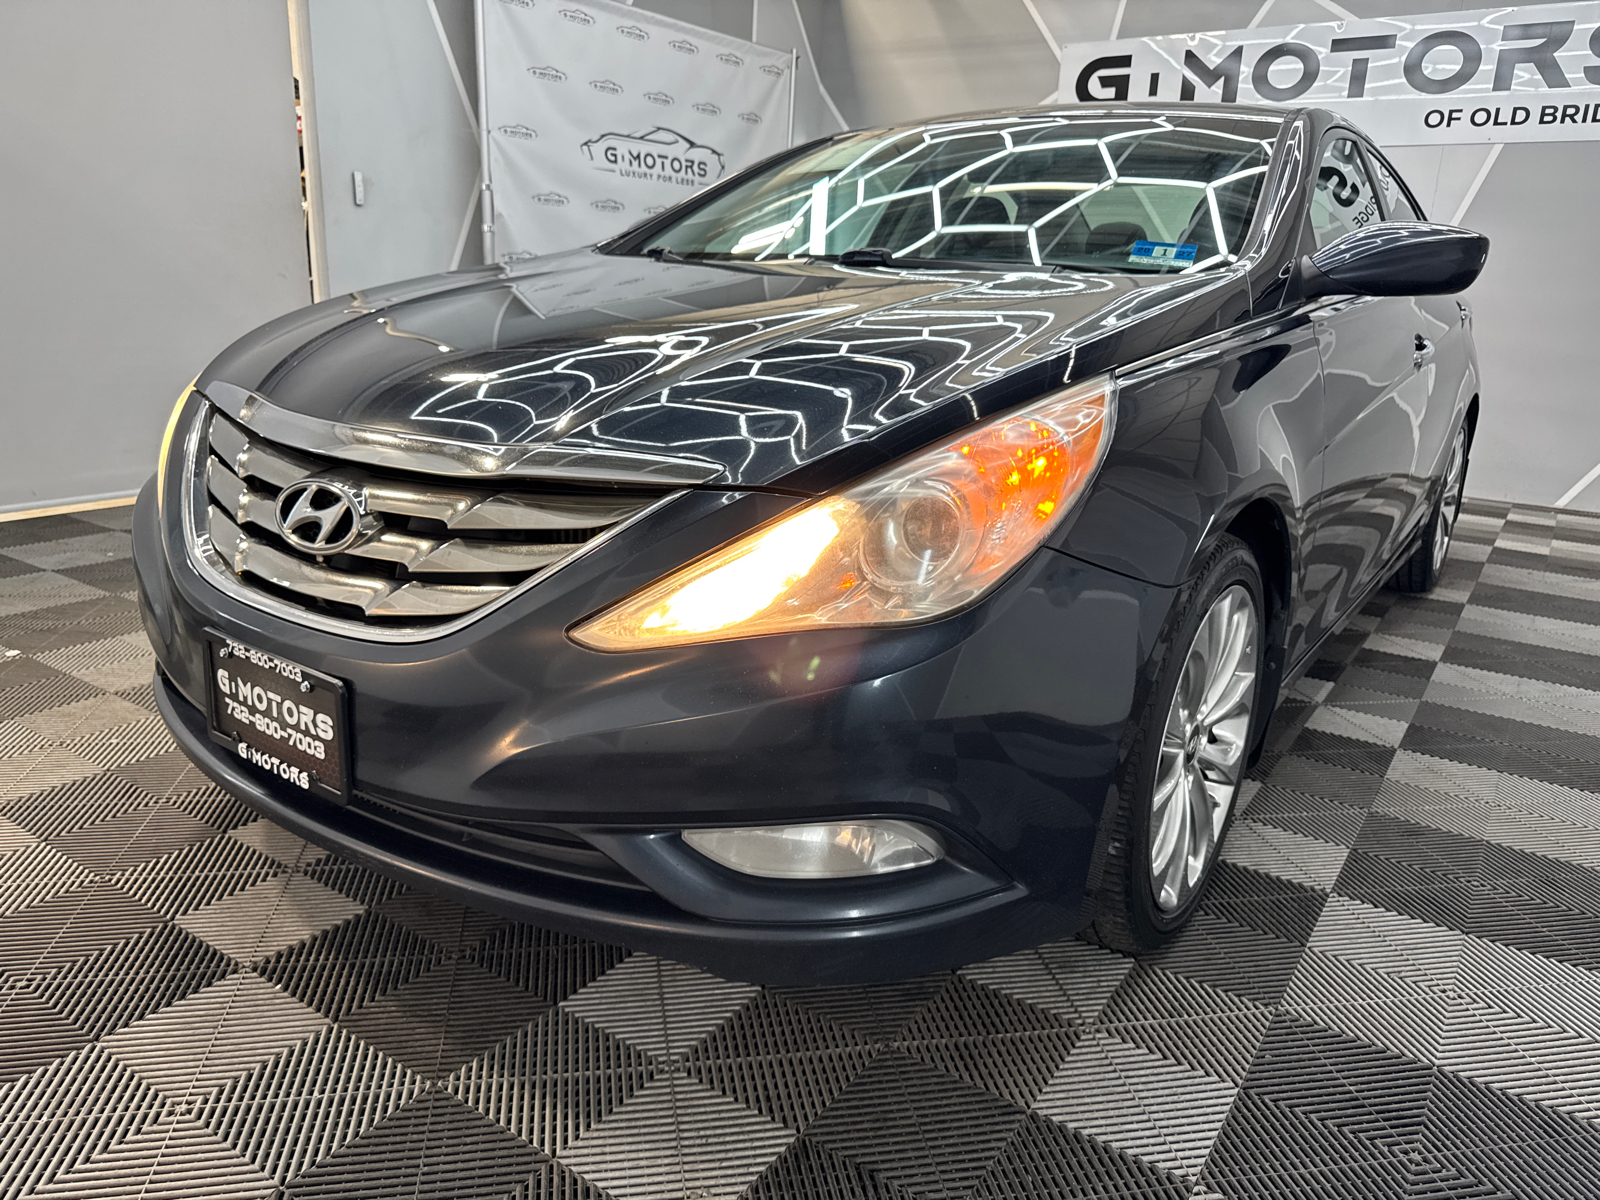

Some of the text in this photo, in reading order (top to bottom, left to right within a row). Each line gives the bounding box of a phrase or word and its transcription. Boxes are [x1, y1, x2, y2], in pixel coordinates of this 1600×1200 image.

[1182, 21, 1600, 103] MOTOR
[1424, 109, 1463, 128] OF
[1470, 106, 1531, 127] OLD
[620, 169, 695, 187] LUXURY FOR LESS
[1161, 248, 1168, 256] 1
[226, 639, 303, 682] 732-800-7003
[224, 697, 325, 760] 732-800-7003
